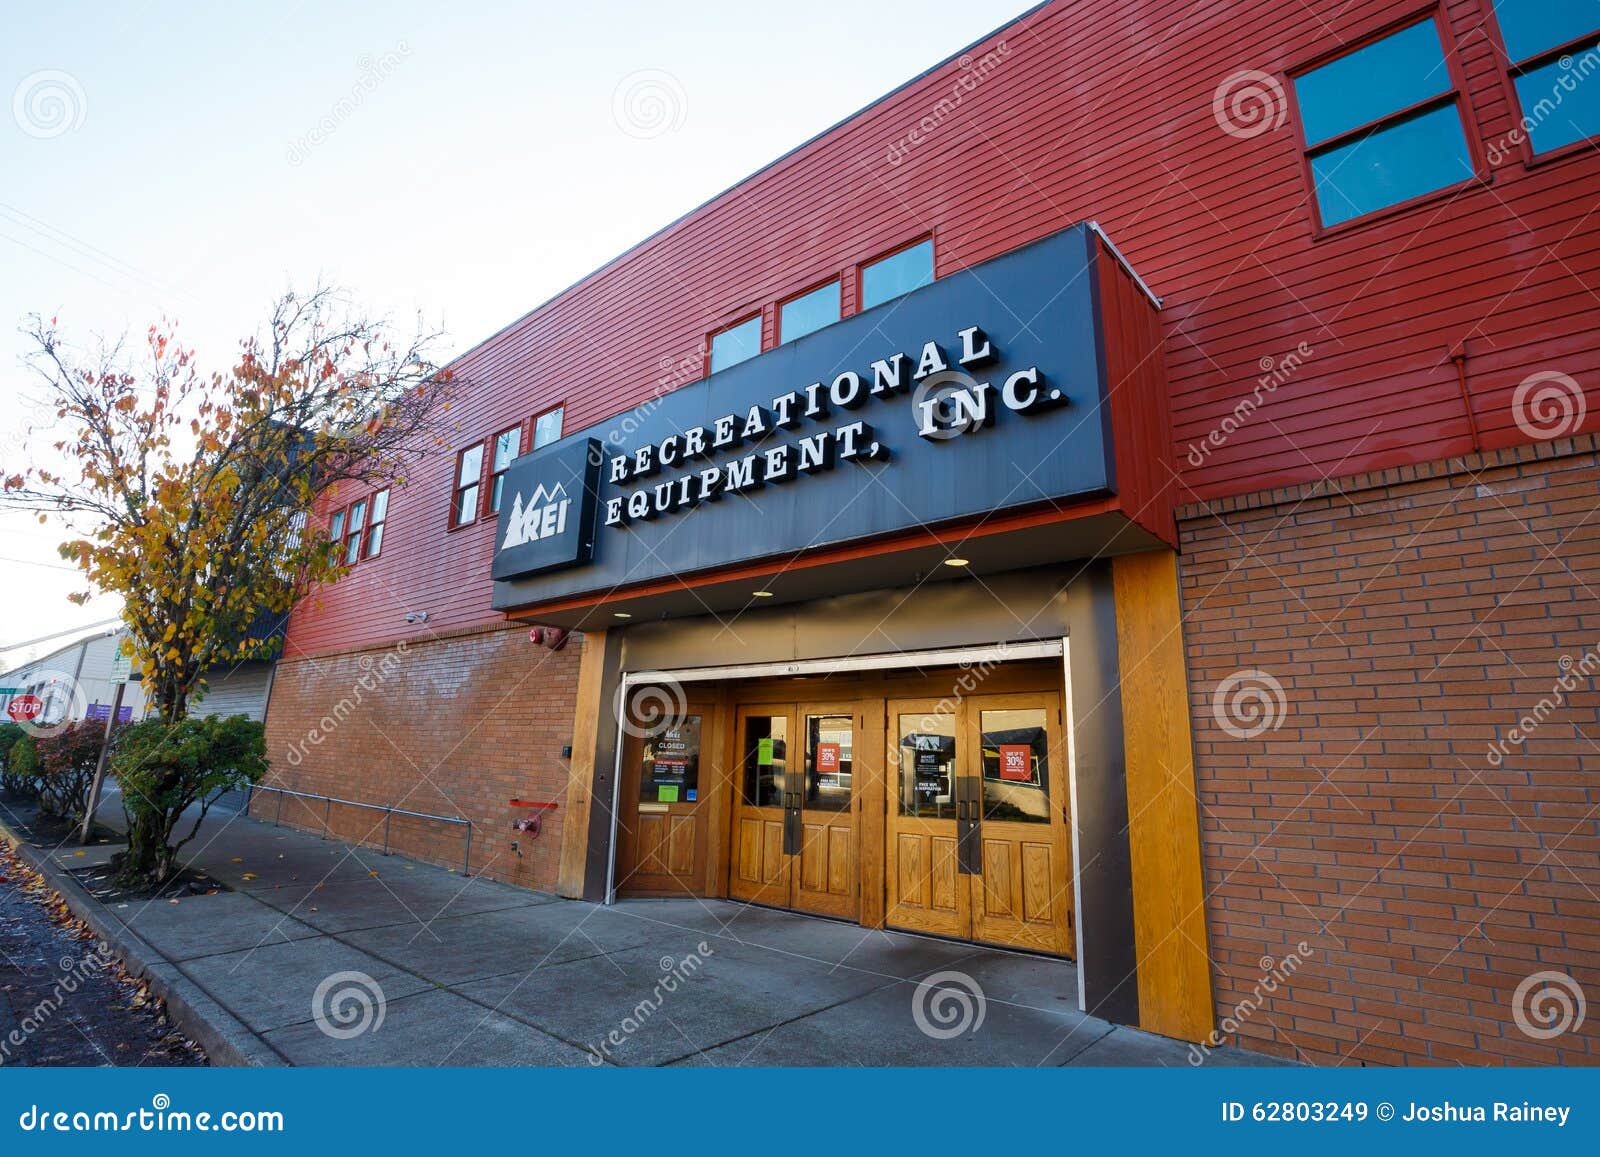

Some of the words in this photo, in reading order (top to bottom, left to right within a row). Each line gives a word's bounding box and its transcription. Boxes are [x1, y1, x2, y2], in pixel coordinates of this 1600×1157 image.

[609, 326, 991, 483] RECREATIONAL
[605, 421, 880, 526] EQUIPMENT,
[918, 366, 1062, 437] INC.
[521, 499, 568, 543] REI
[9, 703, 41, 713] STOP
[658, 742, 686, 750] CLOSED
[822, 752, 835, 761] 30%
[1006, 756, 1025, 766] 30%
